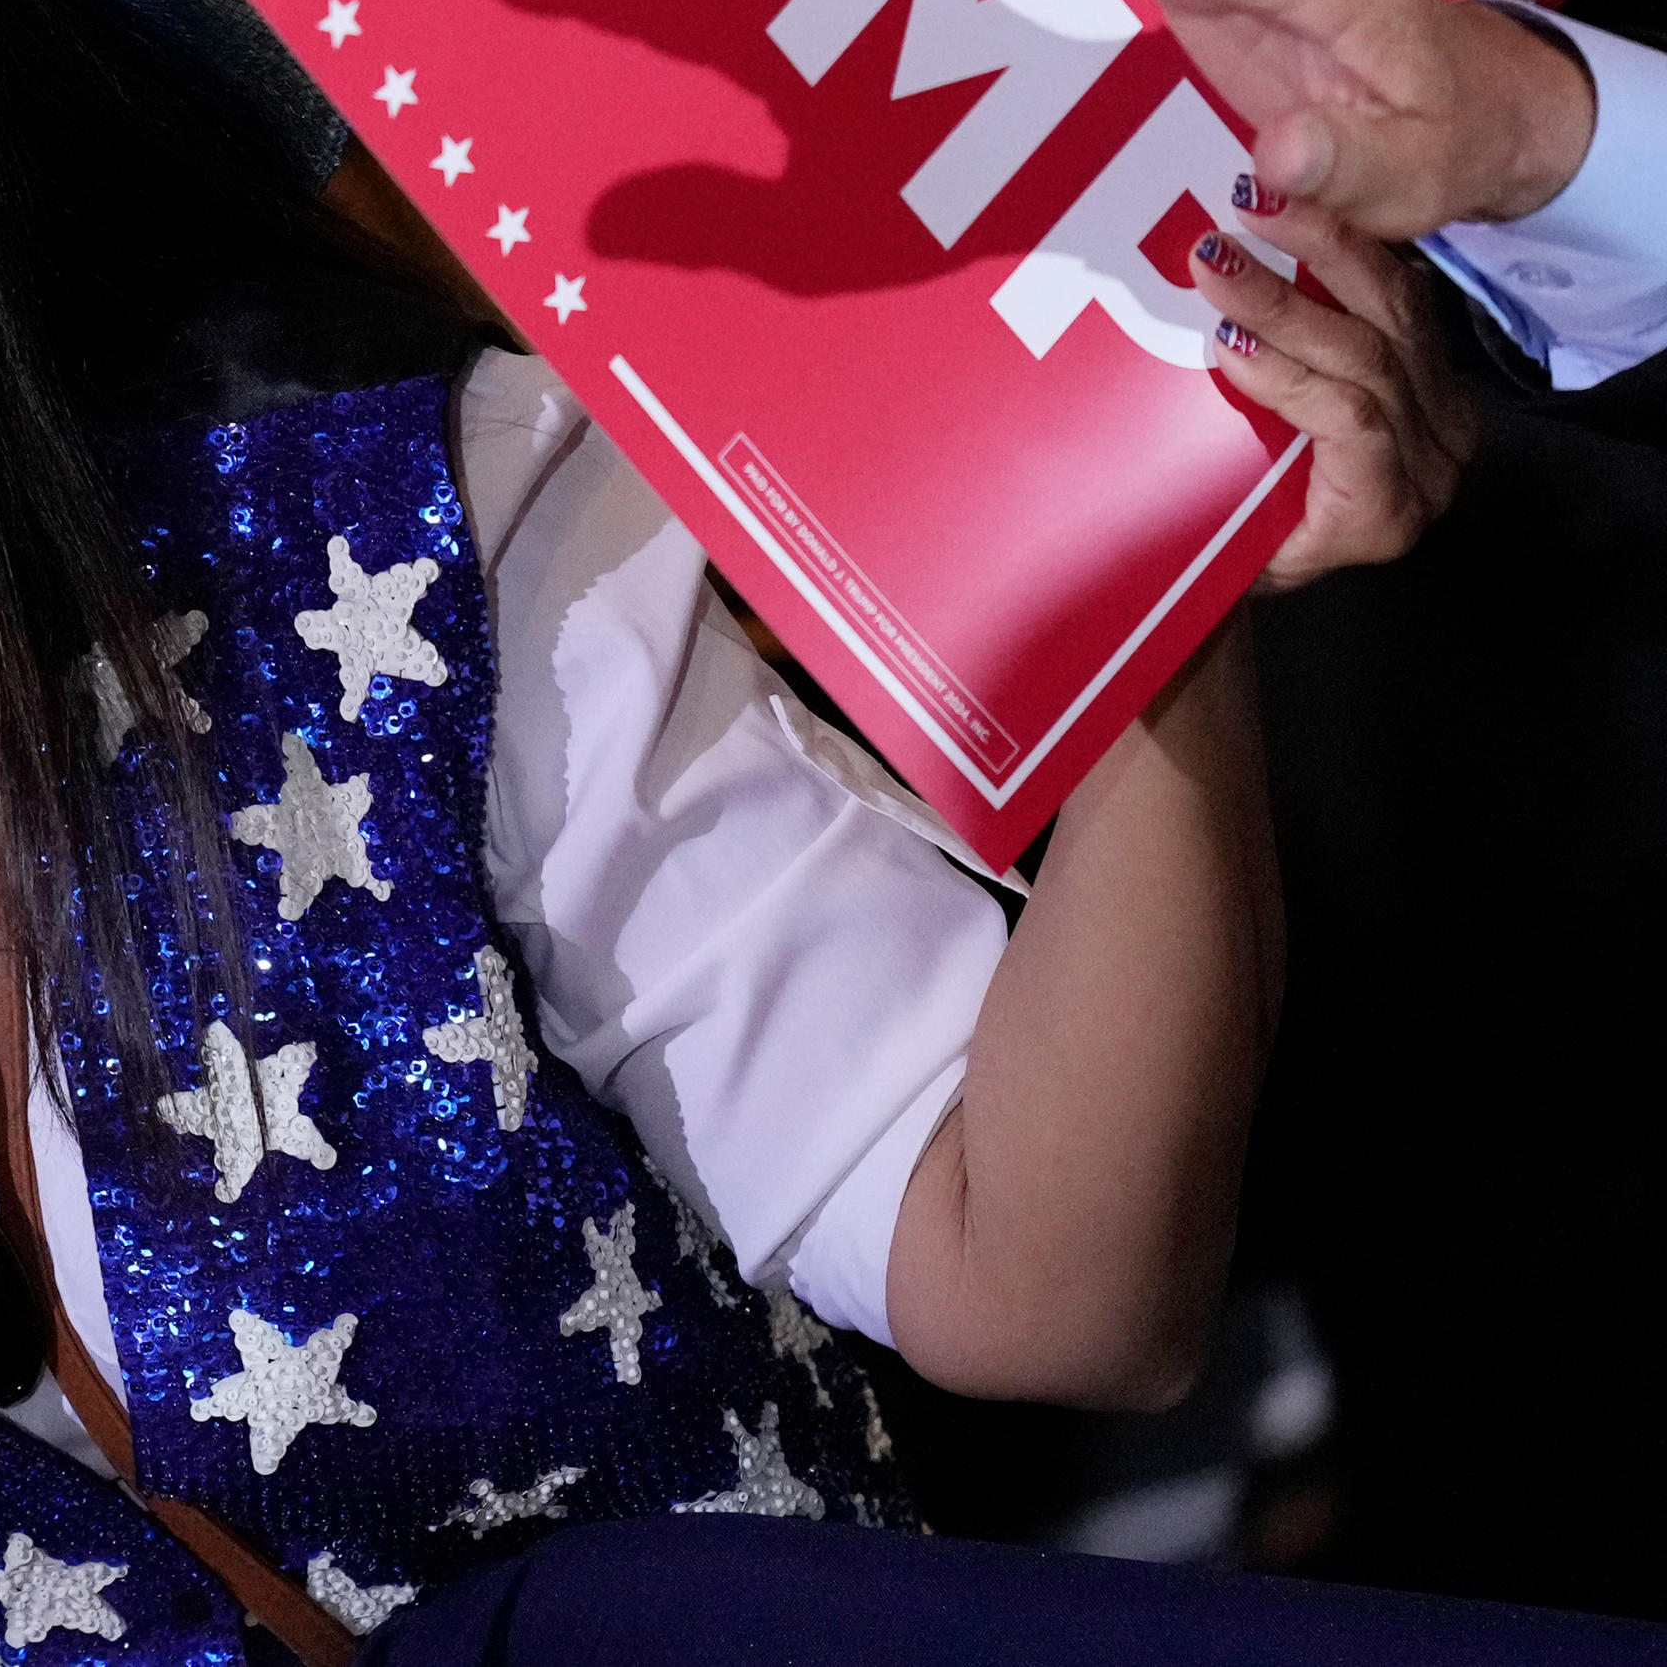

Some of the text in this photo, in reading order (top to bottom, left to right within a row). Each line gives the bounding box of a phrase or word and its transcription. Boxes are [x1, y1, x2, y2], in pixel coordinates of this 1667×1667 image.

[740, 460, 771, 493] PAID
[761, 485, 790, 514] FOR
[793, 523, 841, 573] DONALD
[840, 575, 880, 618] TRUMP
[871, 610, 900, 640] FOR
[891, 633, 948, 694] PRESIDENT
